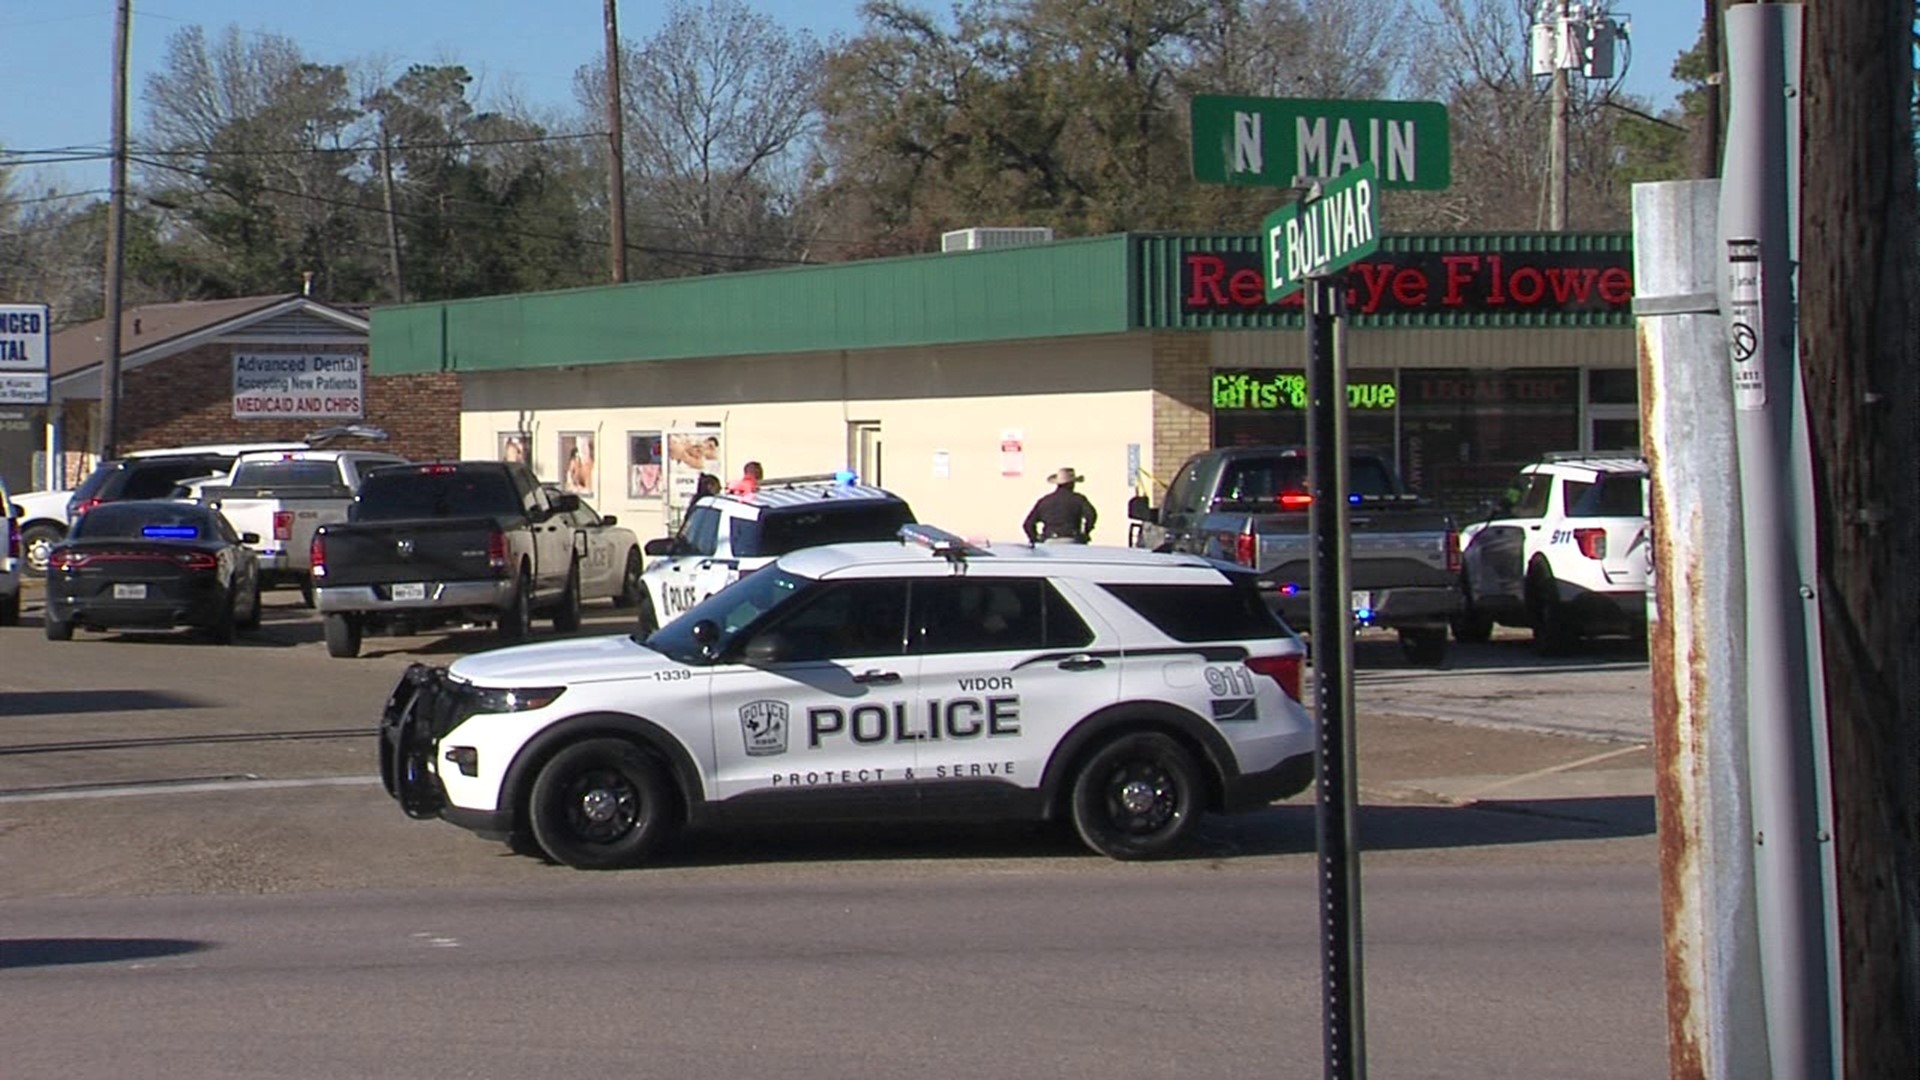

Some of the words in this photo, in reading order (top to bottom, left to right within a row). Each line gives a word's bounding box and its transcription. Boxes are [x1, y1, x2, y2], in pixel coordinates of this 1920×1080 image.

[1233, 111, 1262, 174] N
[1296, 116, 1414, 182] MAIN
[1269, 225, 1283, 290] E
[1286, 178, 1373, 281] BOLIVAR
[1187, 256, 1311, 305] Re
[1346, 262, 1428, 312] ye
[238, 357, 306, 372] Advanced
[313, 357, 358, 372] Dental
[238, 377, 288, 392] Accepting
[291, 377, 314, 389] New
[316, 377, 357, 389] Patients
[1213, 375, 1277, 408] Gifts
[237, 398, 294, 412] MEDICAID
[298, 398, 322, 411] AND
[325, 398, 359, 412] CHIPS
[1550, 529, 1572, 546] 911
[654, 670, 691, 682] 1339
[958, 677, 1014, 692] VIDOR
[1203, 666, 1255, 697] 911
[744, 702, 786, 722] POLICE
[807, 694, 1022, 749] POLICE
[772, 769, 884, 785] PROTECT
[905, 768, 915, 781] &
[937, 762, 1016, 777] SERVE
